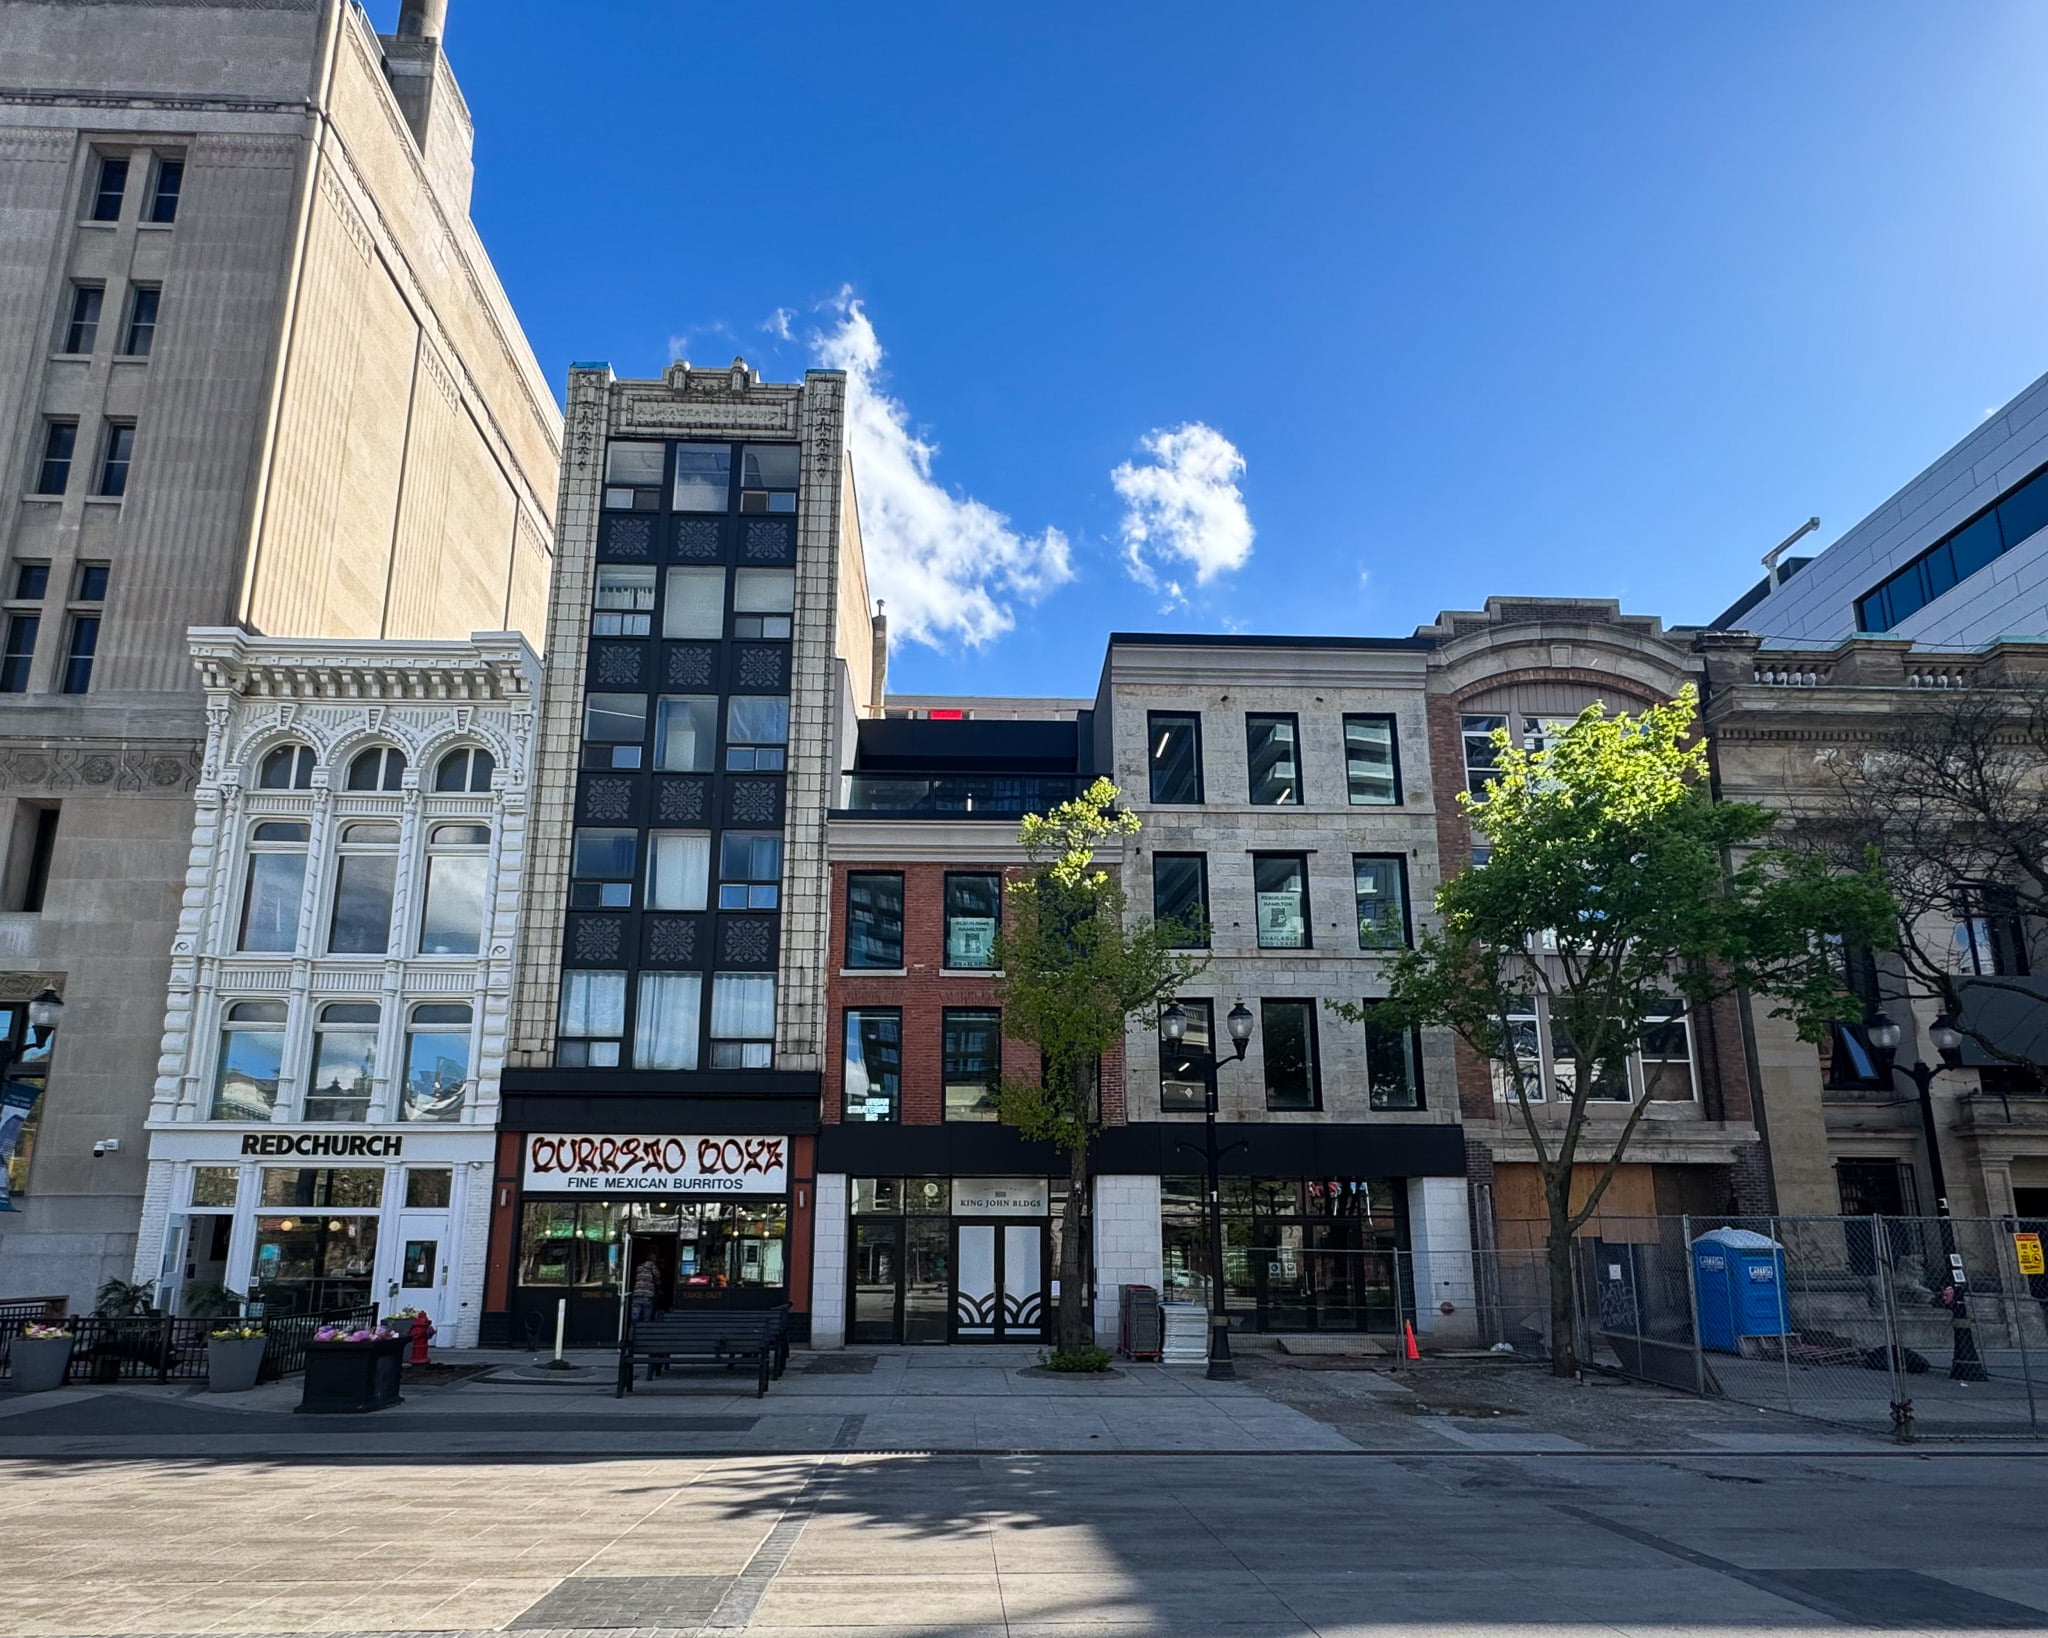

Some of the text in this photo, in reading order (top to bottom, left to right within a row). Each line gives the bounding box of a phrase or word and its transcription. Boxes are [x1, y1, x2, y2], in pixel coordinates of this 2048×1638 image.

[241, 1134, 403, 1156] REDCHURCH
[531, 1136, 784, 1175] BURRITO BOYZ
[567, 1177, 744, 1190] FINE MEXICAN BURRITOS
[985, 1200, 1010, 1208] JOHN
[1012, 1200, 1042, 1208] BLDGS
